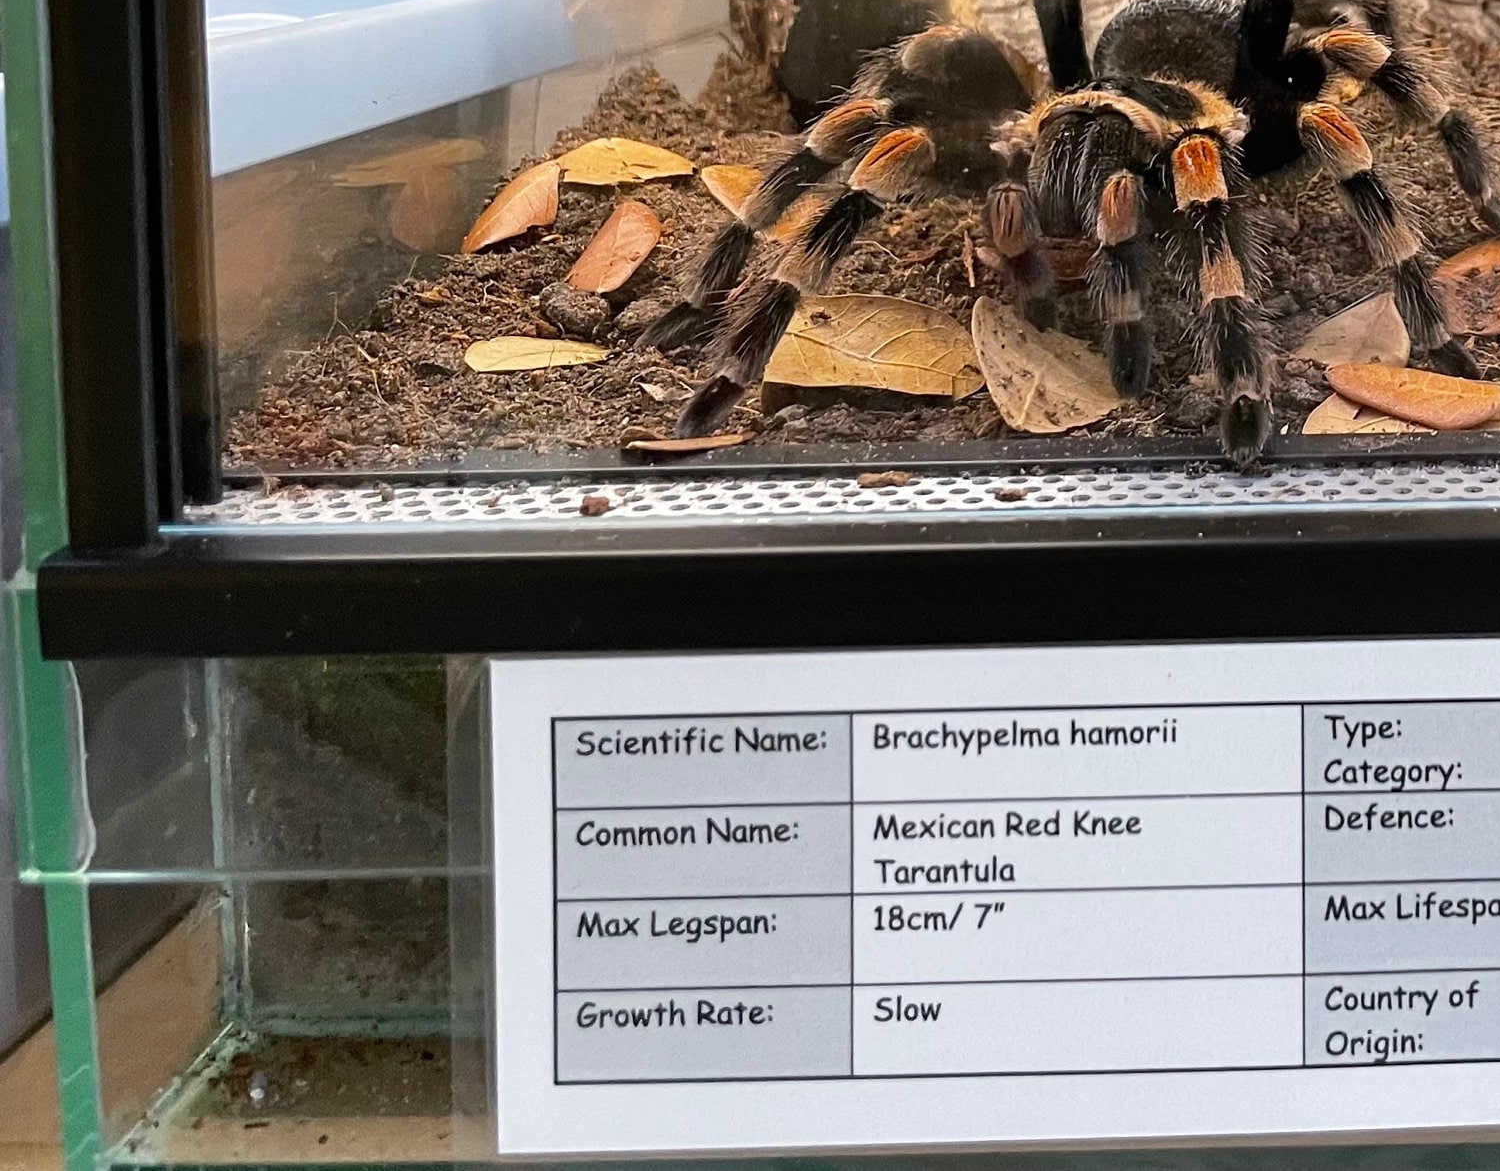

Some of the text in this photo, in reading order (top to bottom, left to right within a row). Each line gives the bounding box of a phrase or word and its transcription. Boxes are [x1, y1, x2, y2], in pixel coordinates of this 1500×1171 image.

[576, 727, 826, 757] Scientific Name:
[873, 718, 1177, 756] Brachypelma hamorii
[1323, 715, 1402, 744] Type:
[1324, 758, 1462, 788] Category:
[576, 817, 798, 847] Common Name:
[873, 810, 1141, 840] Mexican Red Knee
[1325, 803, 1454, 831] Defence:
[873, 855, 1015, 884] Tarantula
[874, 903, 963, 931] 18cm/
[1324, 895, 1386, 921] Max
[577, 910, 777, 944] Max Legspan:
[874, 995, 942, 1022] Slow
[1325, 980, 1479, 1016] Country of
[576, 1000, 773, 1029] Growth Rate:
[1325, 1029, 1425, 1062] Origin:
